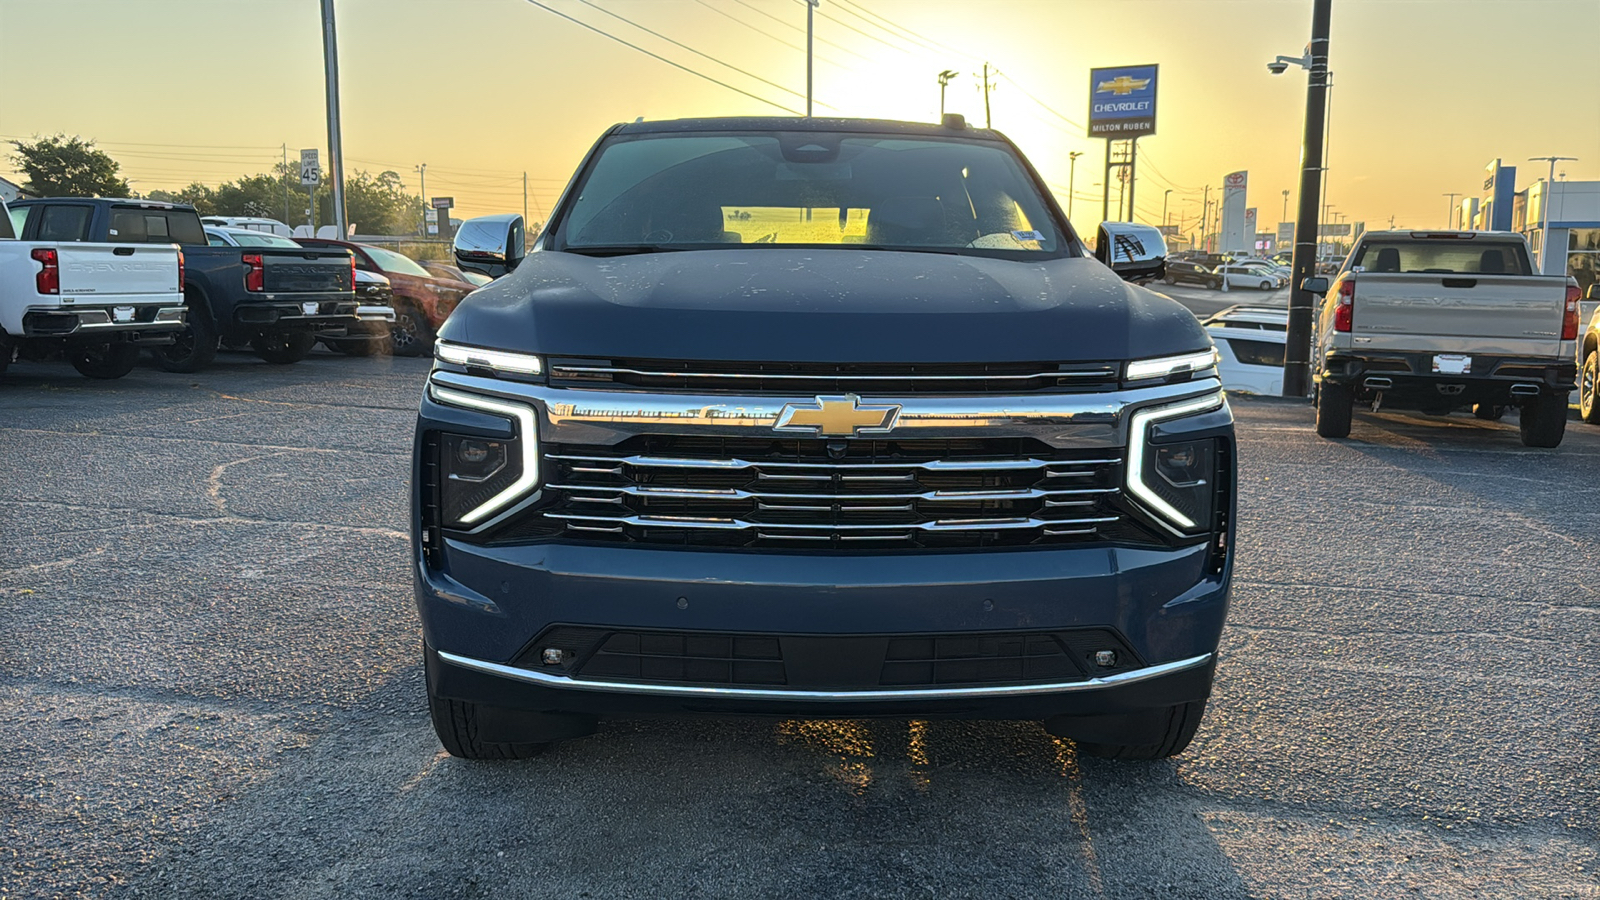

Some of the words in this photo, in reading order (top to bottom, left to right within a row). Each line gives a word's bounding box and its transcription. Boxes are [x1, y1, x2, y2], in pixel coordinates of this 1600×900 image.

[1094, 101, 1149, 113] CHEVROLET
[1092, 123, 1120, 132] MILTON
[1123, 122, 1150, 131] RUBEN
[302, 168, 318, 182] 45
[68, 262, 173, 274] CHEVROLET
[270, 265, 348, 275] CHEVROLET
